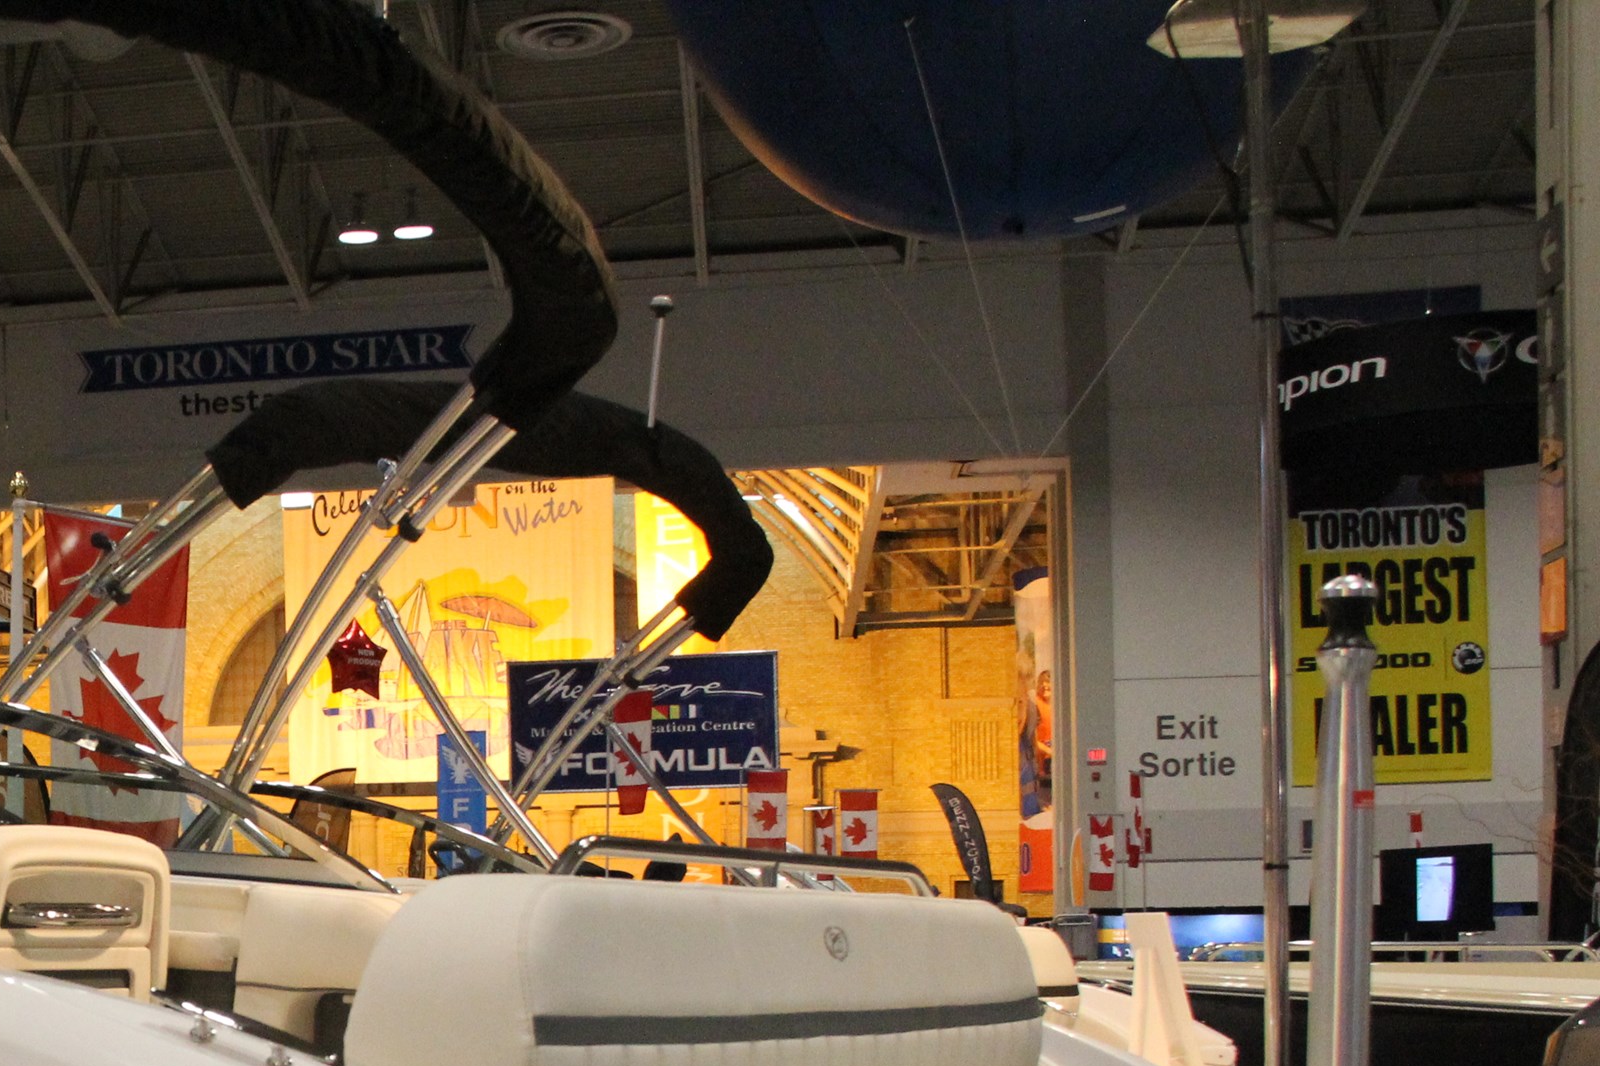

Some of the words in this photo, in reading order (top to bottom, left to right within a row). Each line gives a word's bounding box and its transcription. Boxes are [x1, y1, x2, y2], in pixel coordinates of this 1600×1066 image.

[104, 340, 318, 385] TORONTO
[331, 331, 450, 370] STAR
[531, 480, 557, 493] the
[504, 495, 584, 536] Water
[1300, 505, 1467, 551] TORONTO'S
[1299, 556, 1476, 628] LGEST
[347, 657, 381, 667] PRODUC
[526, 667, 583, 704] The
[701, 720, 756, 731] Centre
[1156, 715, 1218, 740] Exit
[1314, 692, 1468, 758] ALER
[561, 746, 773, 777] FOMULA
[1139, 751, 1236, 778] Sortie
